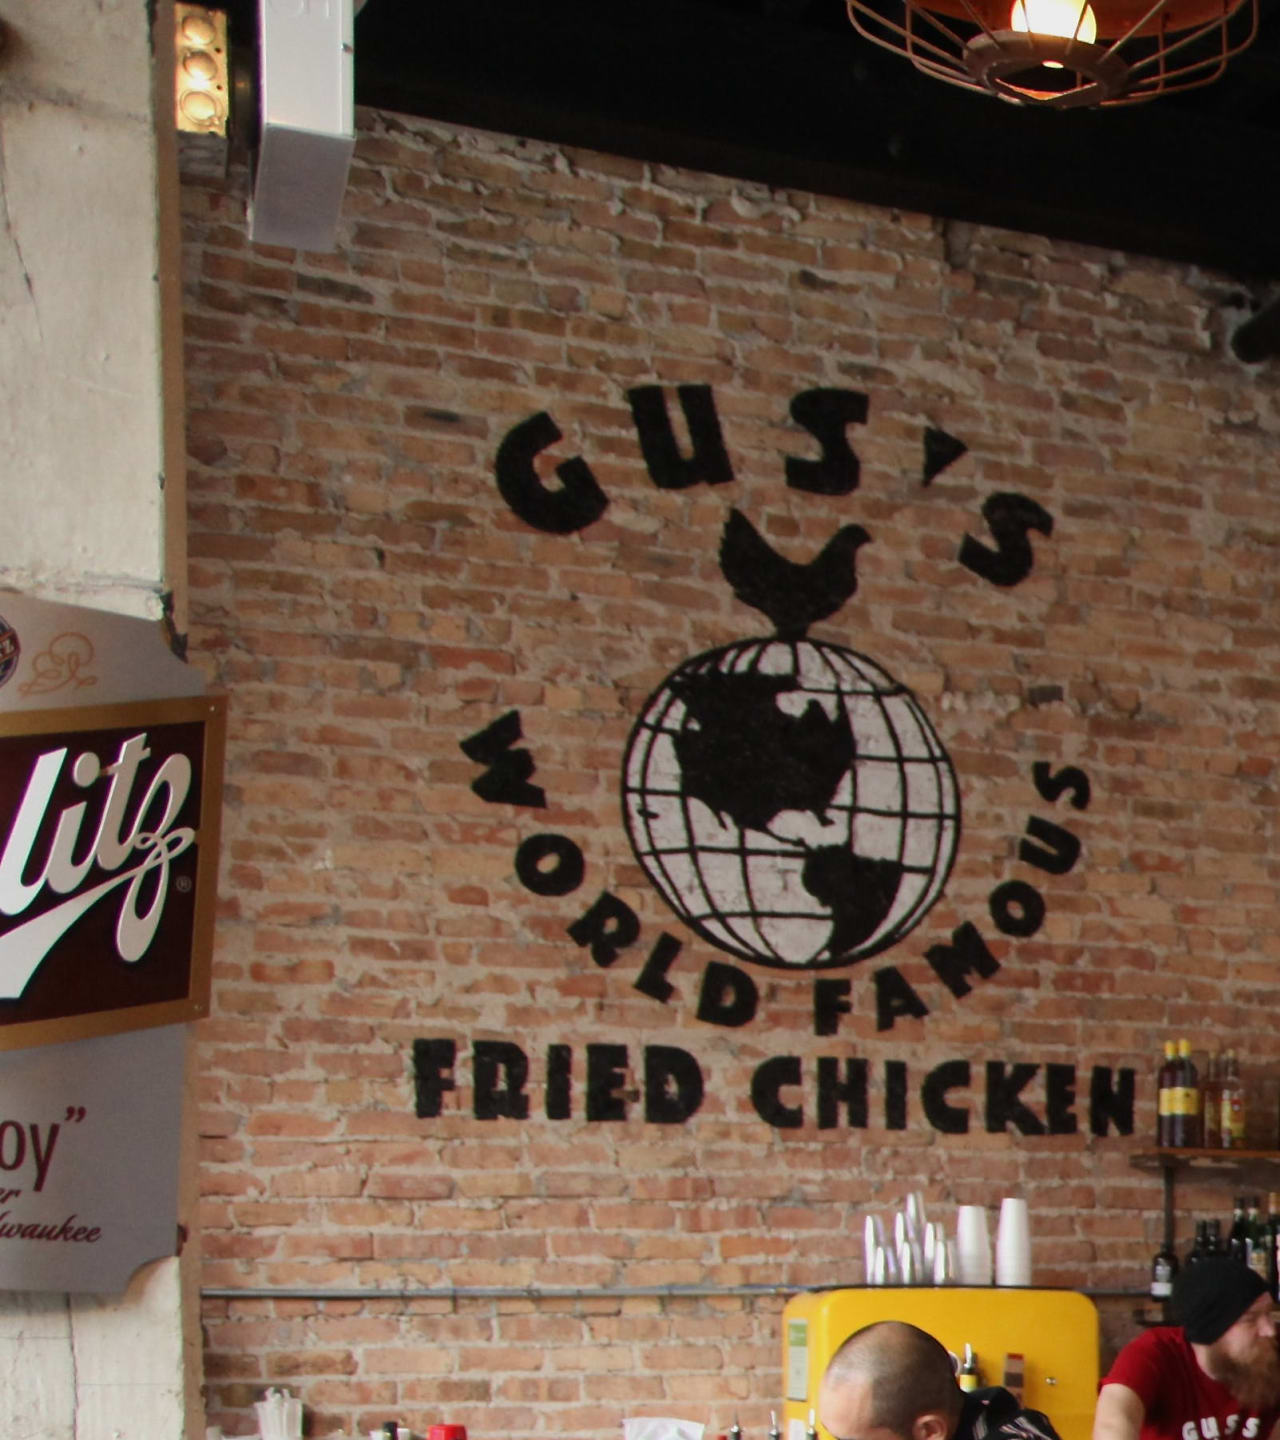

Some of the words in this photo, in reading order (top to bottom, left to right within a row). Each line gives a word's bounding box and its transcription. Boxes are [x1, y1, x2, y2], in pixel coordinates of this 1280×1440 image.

[495, 384, 1054, 588] GUS'S
[458, 709, 760, 1028] WORLD
[814, 759, 1092, 1036] FAMOUS
[411, 1038, 704, 1124] FRIED
[750, 1056, 1136, 1137] CHICKEN
